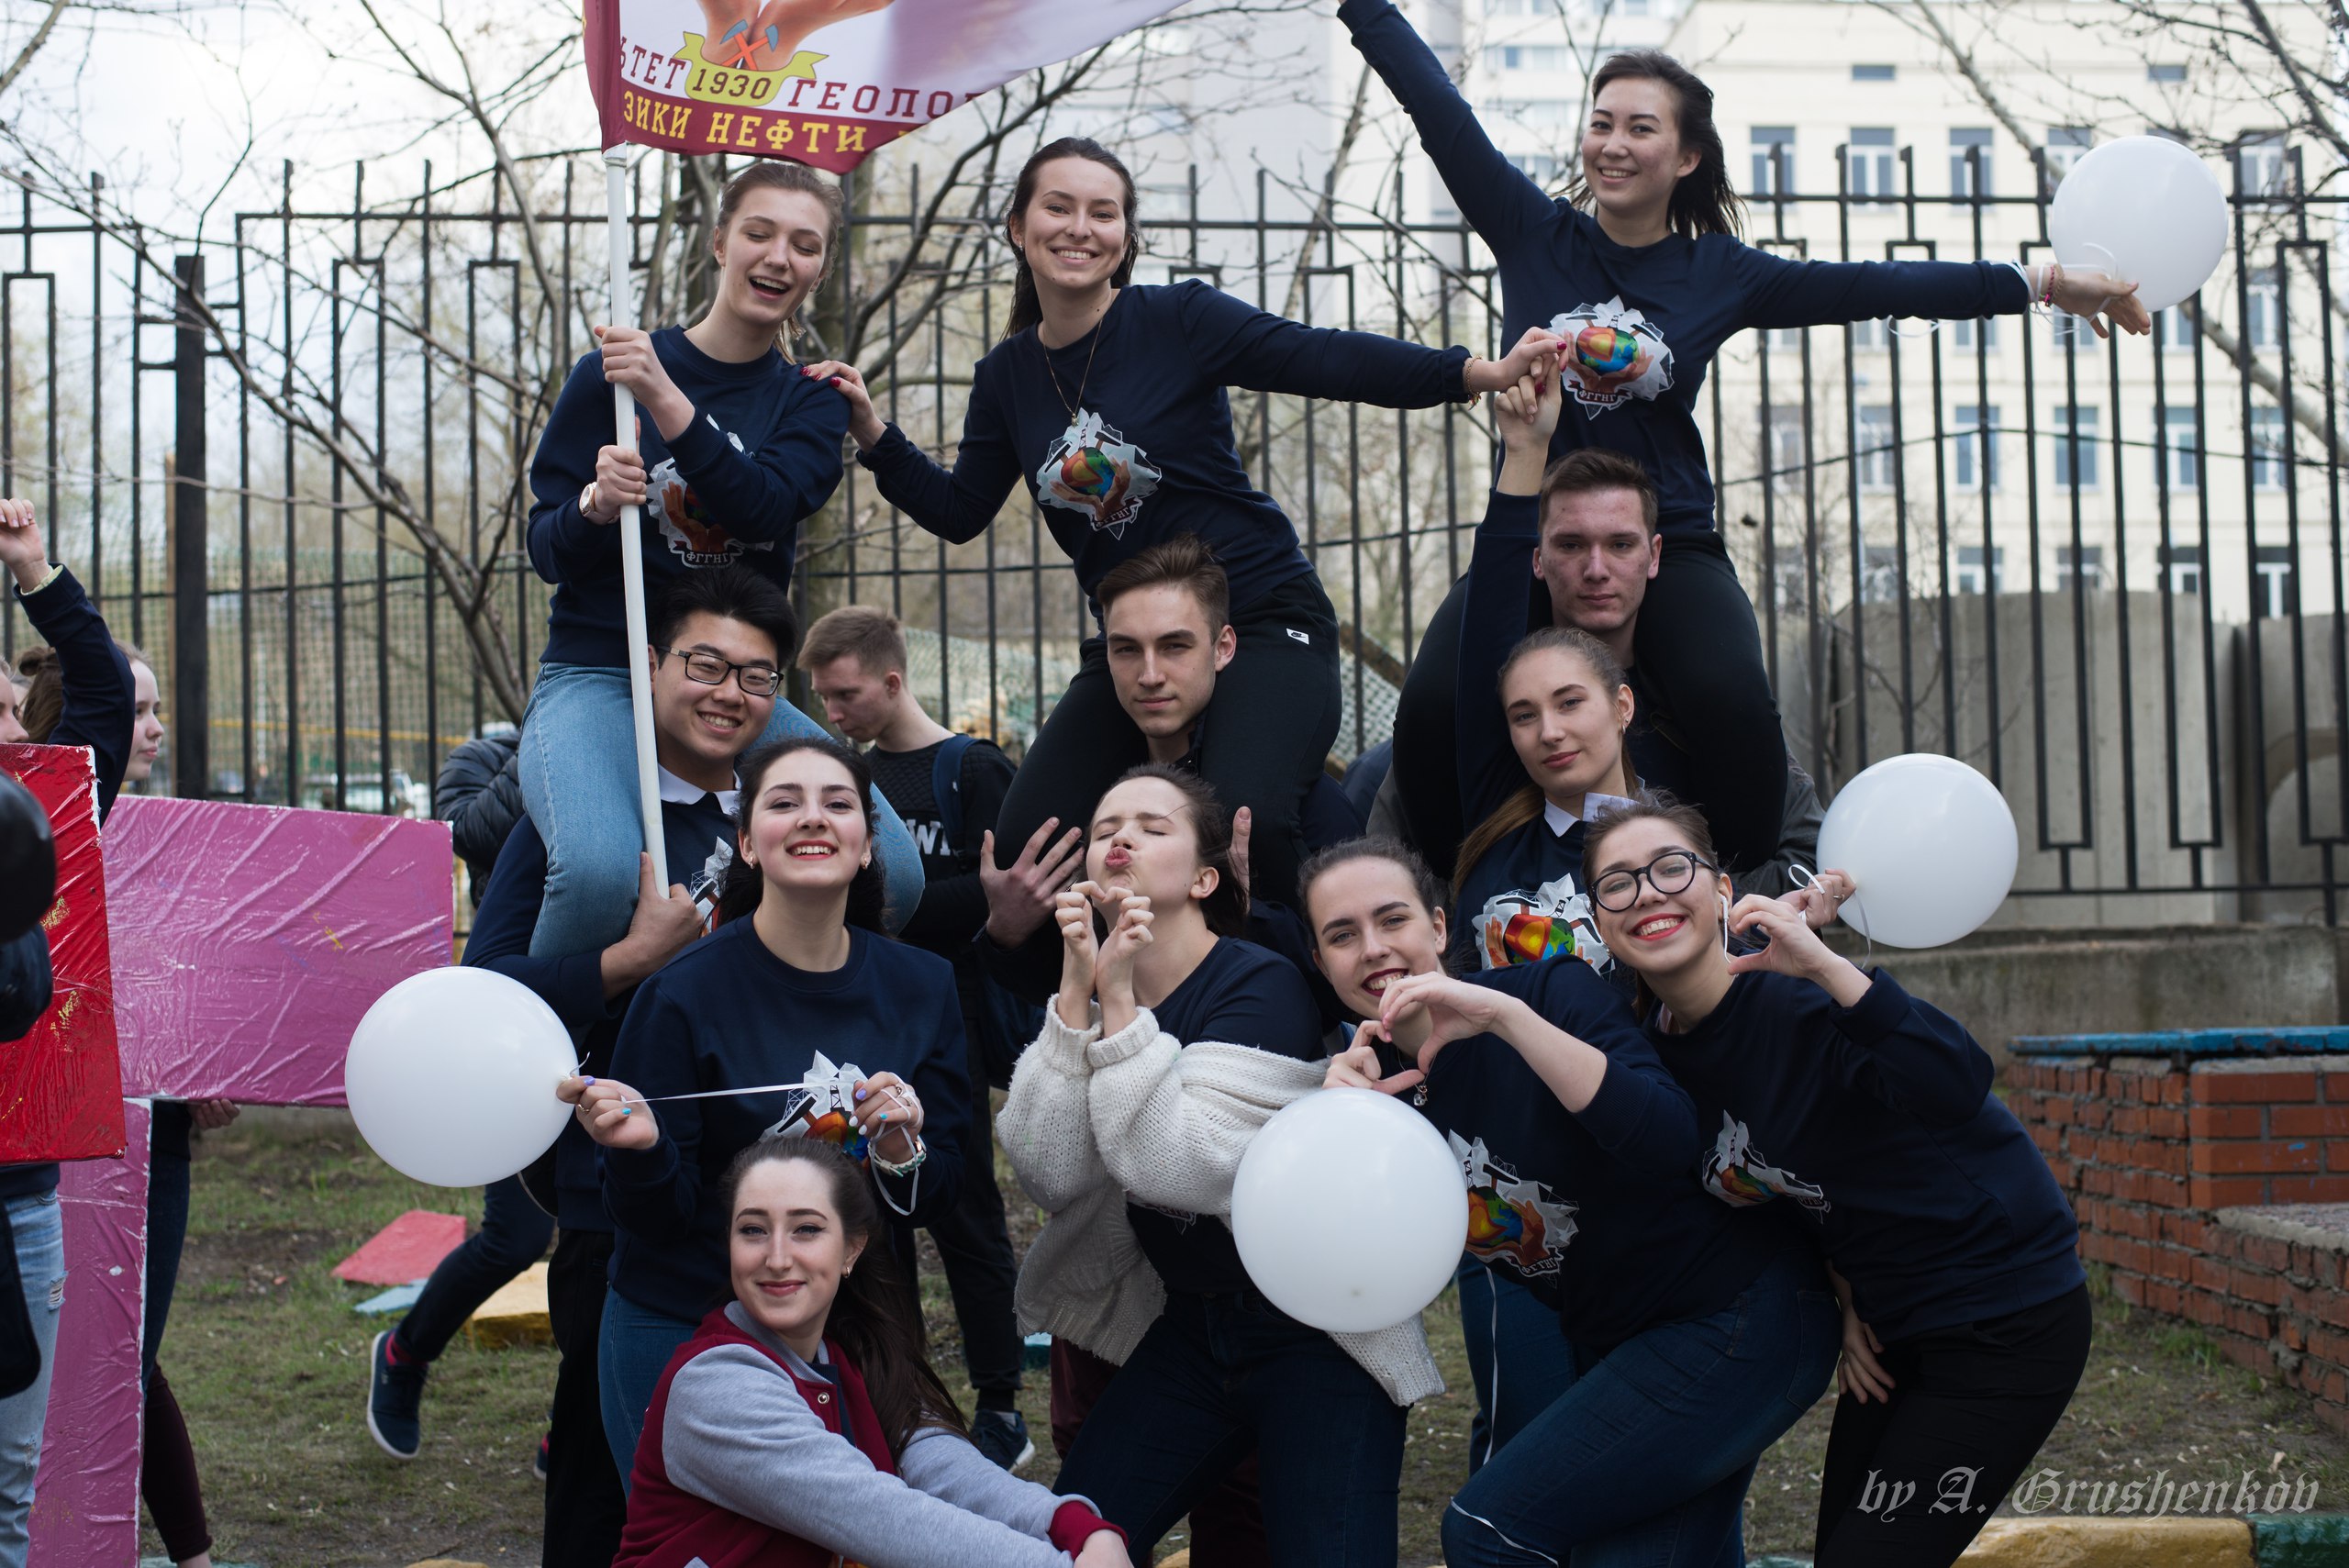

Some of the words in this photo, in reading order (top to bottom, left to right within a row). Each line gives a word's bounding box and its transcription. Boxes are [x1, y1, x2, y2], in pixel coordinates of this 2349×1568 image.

[692, 68, 772, 100] 1930
[787, 79, 987, 119] ГЕОЛО
[624, 90, 693, 139] ЗИКИ
[706, 111, 867, 153] НЕФТИ
[1578, 389, 1617, 403] ФГГНГ
[685, 550, 729, 564] ФГГНГ
